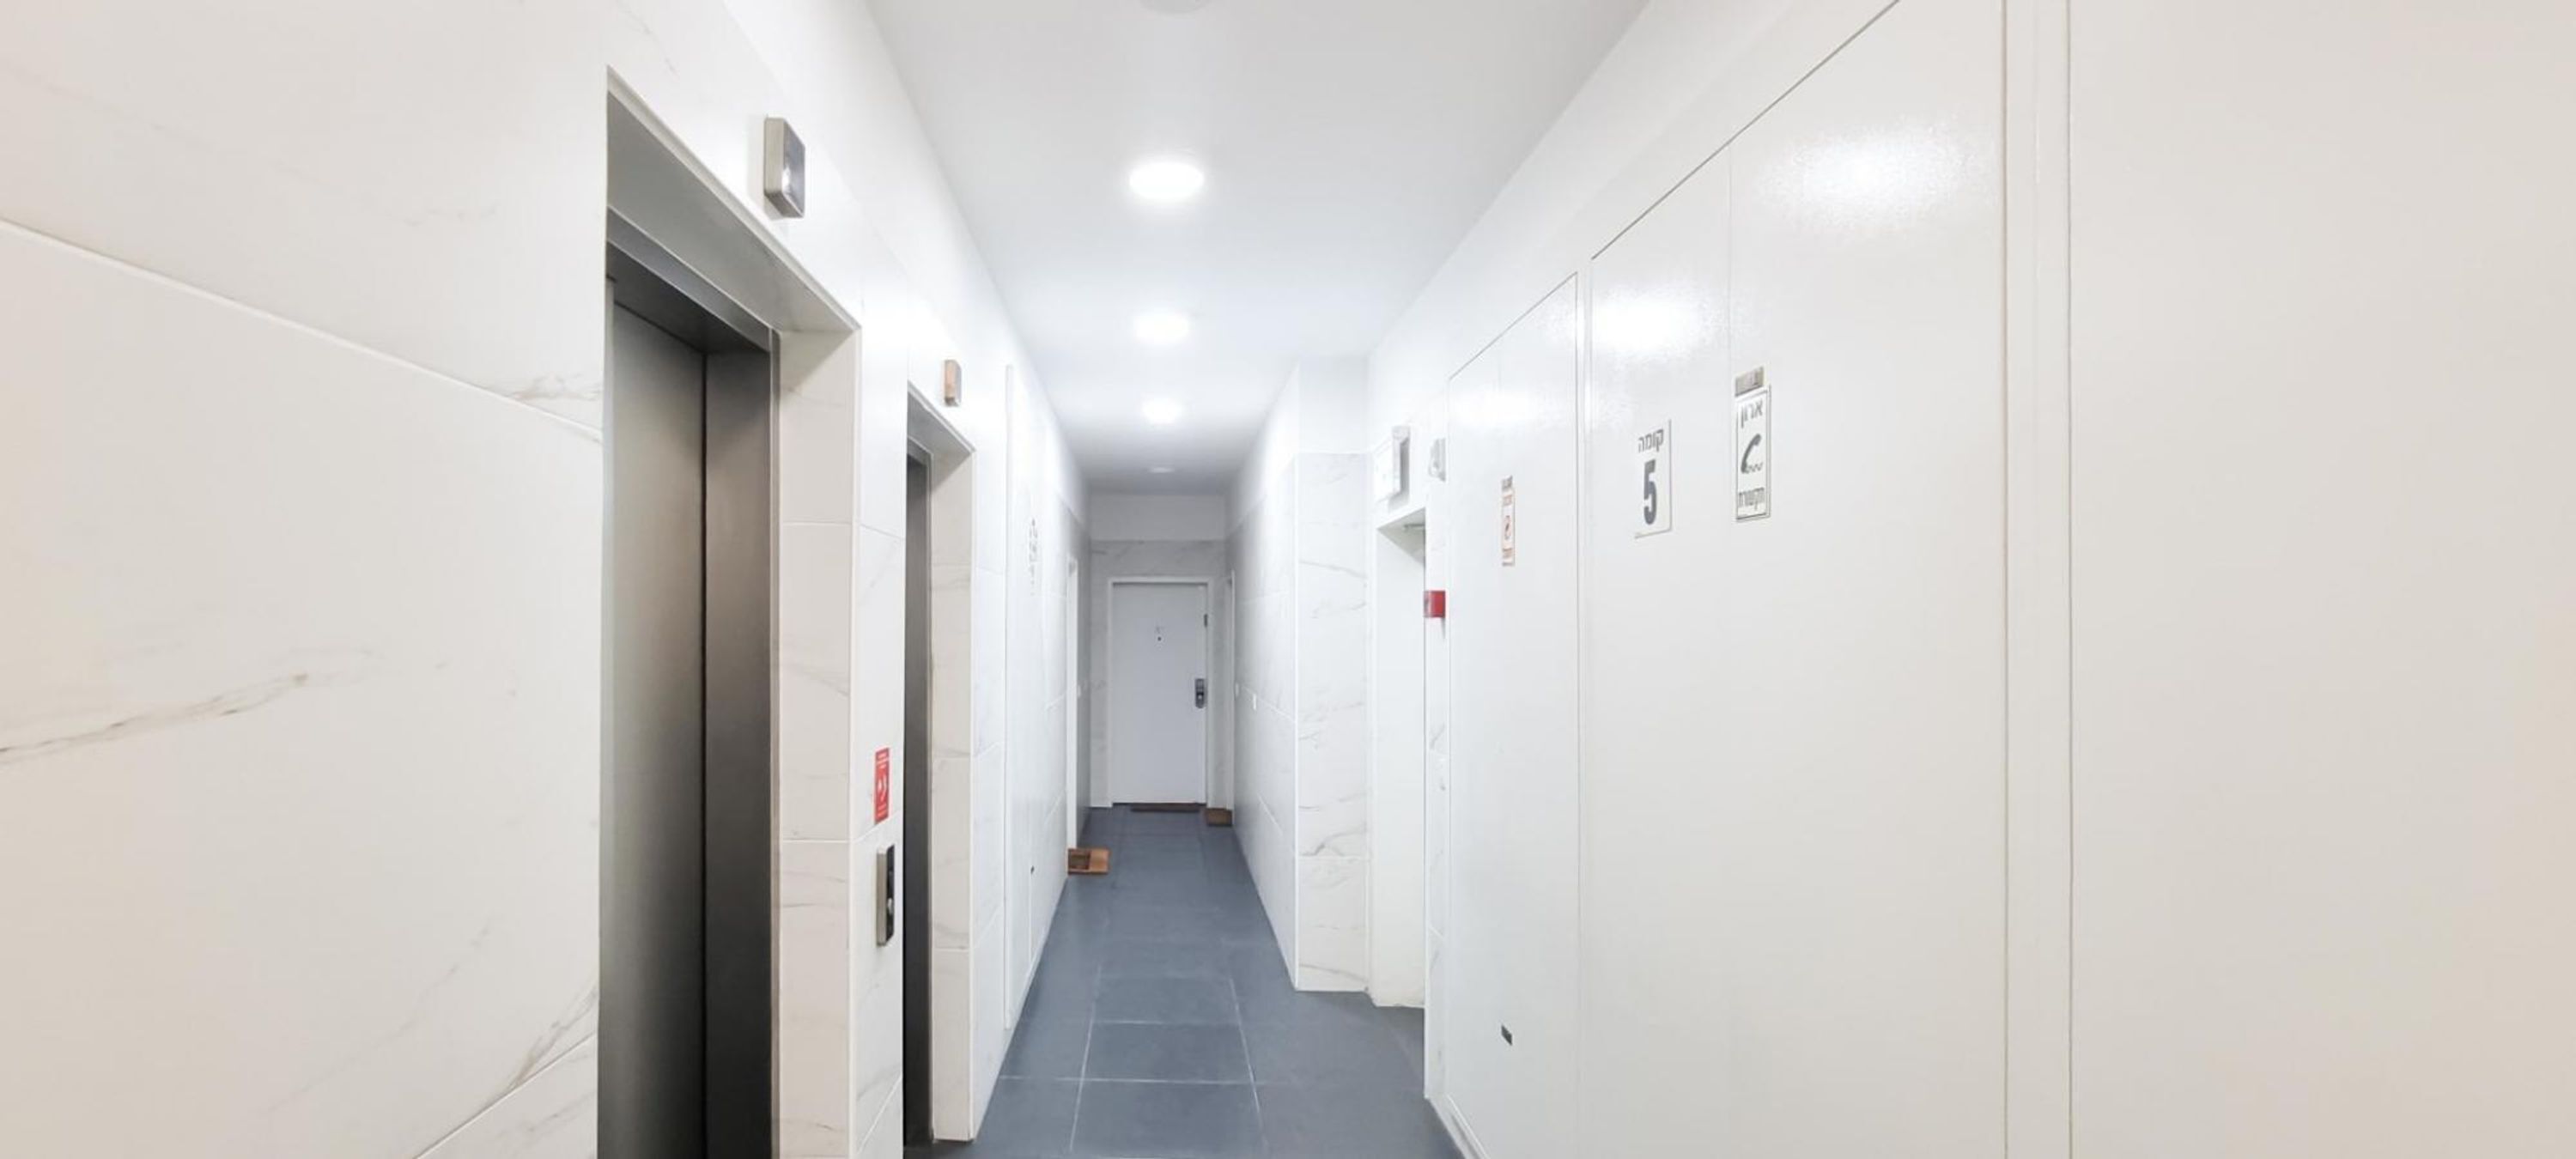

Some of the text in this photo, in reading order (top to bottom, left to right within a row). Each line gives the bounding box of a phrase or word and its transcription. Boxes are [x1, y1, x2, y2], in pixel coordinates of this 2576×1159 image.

[1741, 398, 1763, 428] ארון
[1638, 428, 1664, 452] קומה
[1643, 458, 1657, 525] 5
